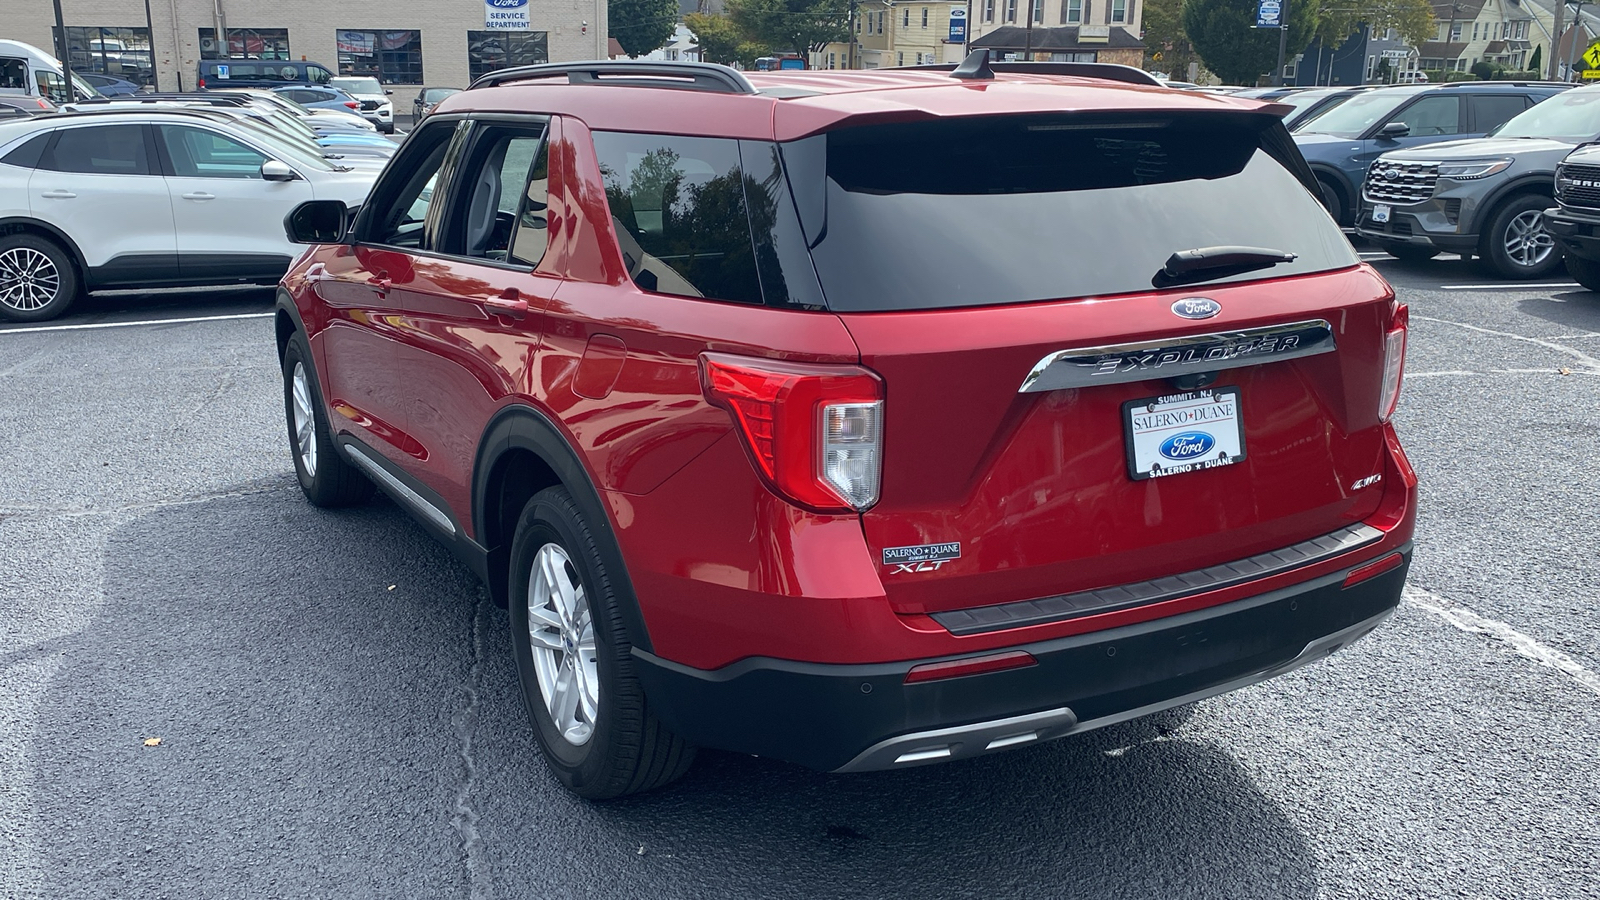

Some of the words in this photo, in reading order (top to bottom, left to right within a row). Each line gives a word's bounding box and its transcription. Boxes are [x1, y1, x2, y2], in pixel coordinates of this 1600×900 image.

[1185, 301, 1213, 314] Ford
[1091, 336, 1299, 375] EXPLORER
[1200, 389, 1213, 399] NJ
[1134, 411, 1188, 430] SALERNO
[1194, 404, 1233, 420] DUANE
[1170, 435, 1204, 456] Ford
[1149, 463, 1192, 478] SALERNO
[1205, 457, 1233, 469] DUANE
[885, 548, 922, 558] SALERNO
[930, 544, 958, 554] DUANE
[890, 560, 950, 574] XLT
